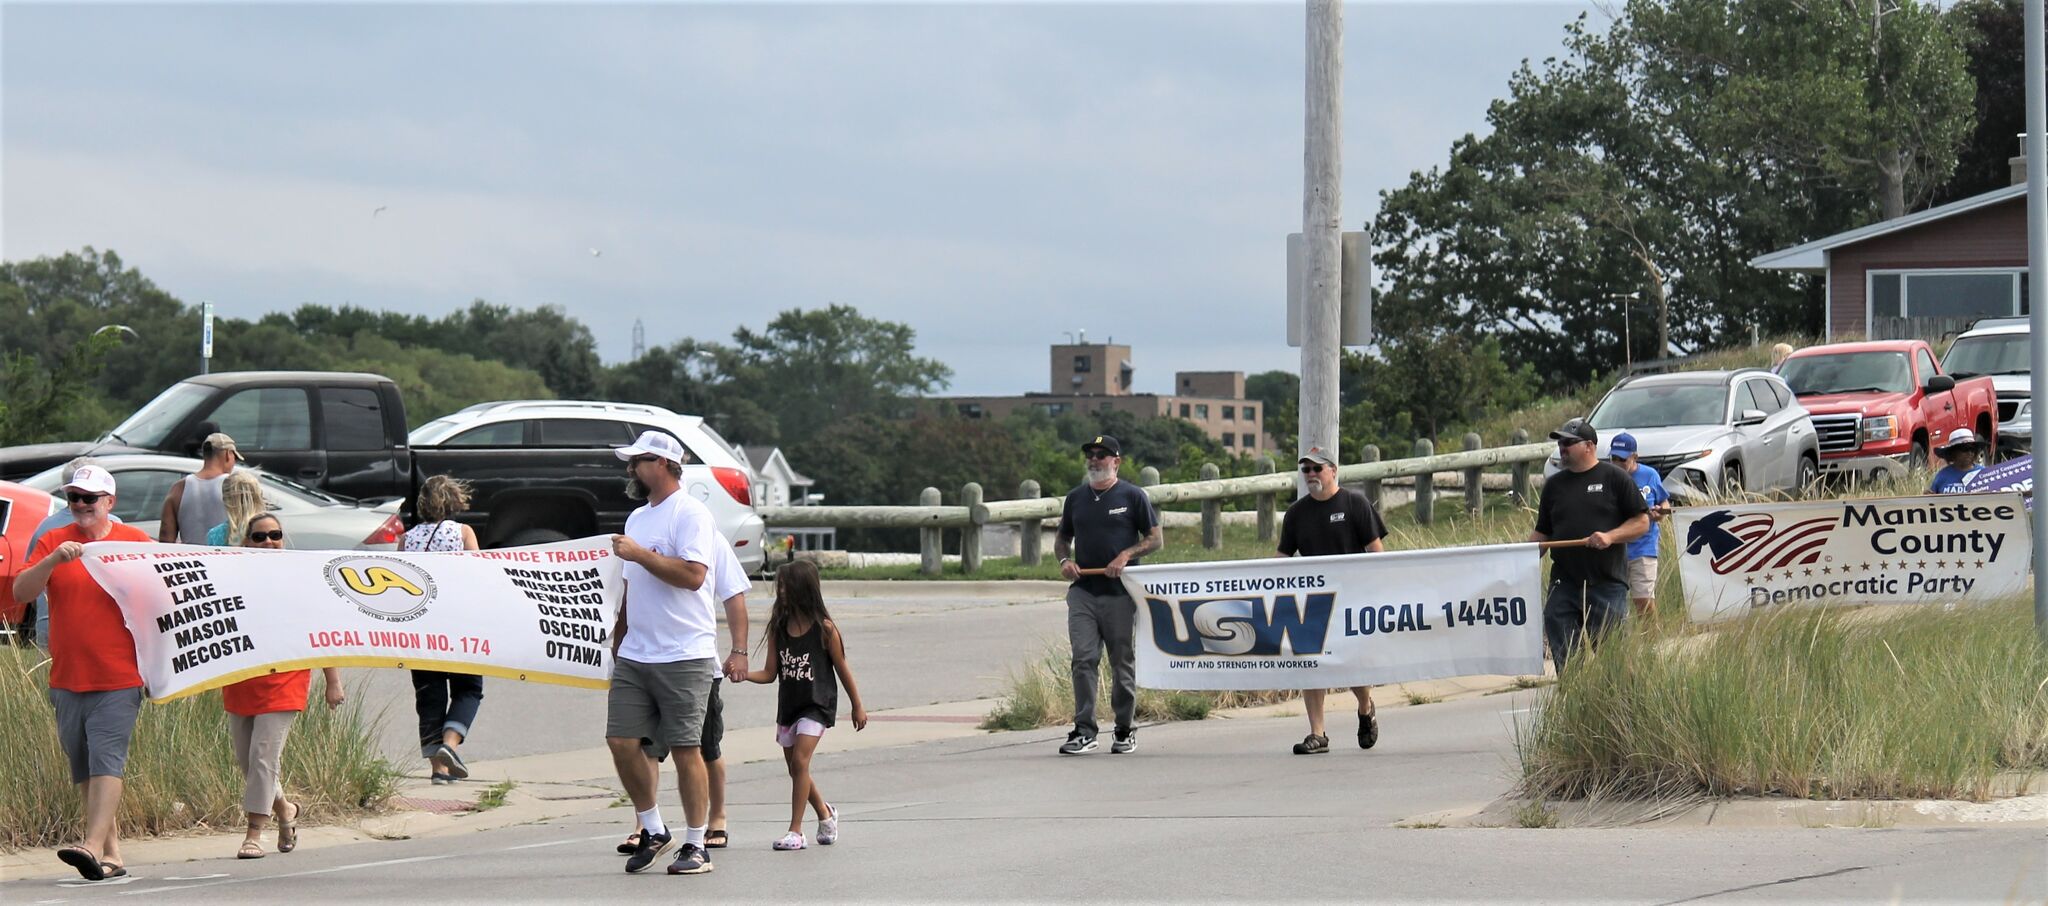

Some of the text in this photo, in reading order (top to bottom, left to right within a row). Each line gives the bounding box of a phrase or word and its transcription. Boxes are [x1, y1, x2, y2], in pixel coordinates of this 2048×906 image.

[1842, 503, 2015, 528] Manistee
[471, 549, 609, 564] SERVICE TRADES
[1870, 528, 2006, 563] County
[98, 553, 147, 564] WEST
[153, 560, 206, 574] IONIA
[163, 569, 209, 588] KENT
[338, 566, 424, 596] UA
[503, 568, 600, 582] MONTCALM
[511, 578, 604, 594] MUSKEGON
[1144, 575, 1326, 595] UNITED STEELWORKERS
[171, 583, 217, 605] LAKE
[523, 590, 604, 605] NEWAYGO
[1750, 572, 1976, 609] Democratic Party
[156, 595, 246, 633] MANISTEE
[537, 603, 604, 623] OCEANA
[1144, 592, 1337, 657] USW
[1344, 596, 1528, 637] LOCAL 14450
[174, 616, 238, 649] MASON
[539, 618, 606, 644] OSCEOLA
[172, 634, 255, 674] MECOSTA
[308, 630, 491, 656] LOCAL UNION NO. 174
[546, 640, 602, 668] OTTAWA
[779, 648, 810, 668] Strong
[1170, 660, 1318, 669] UNITY AND STRENGTH FOR WORKERS
